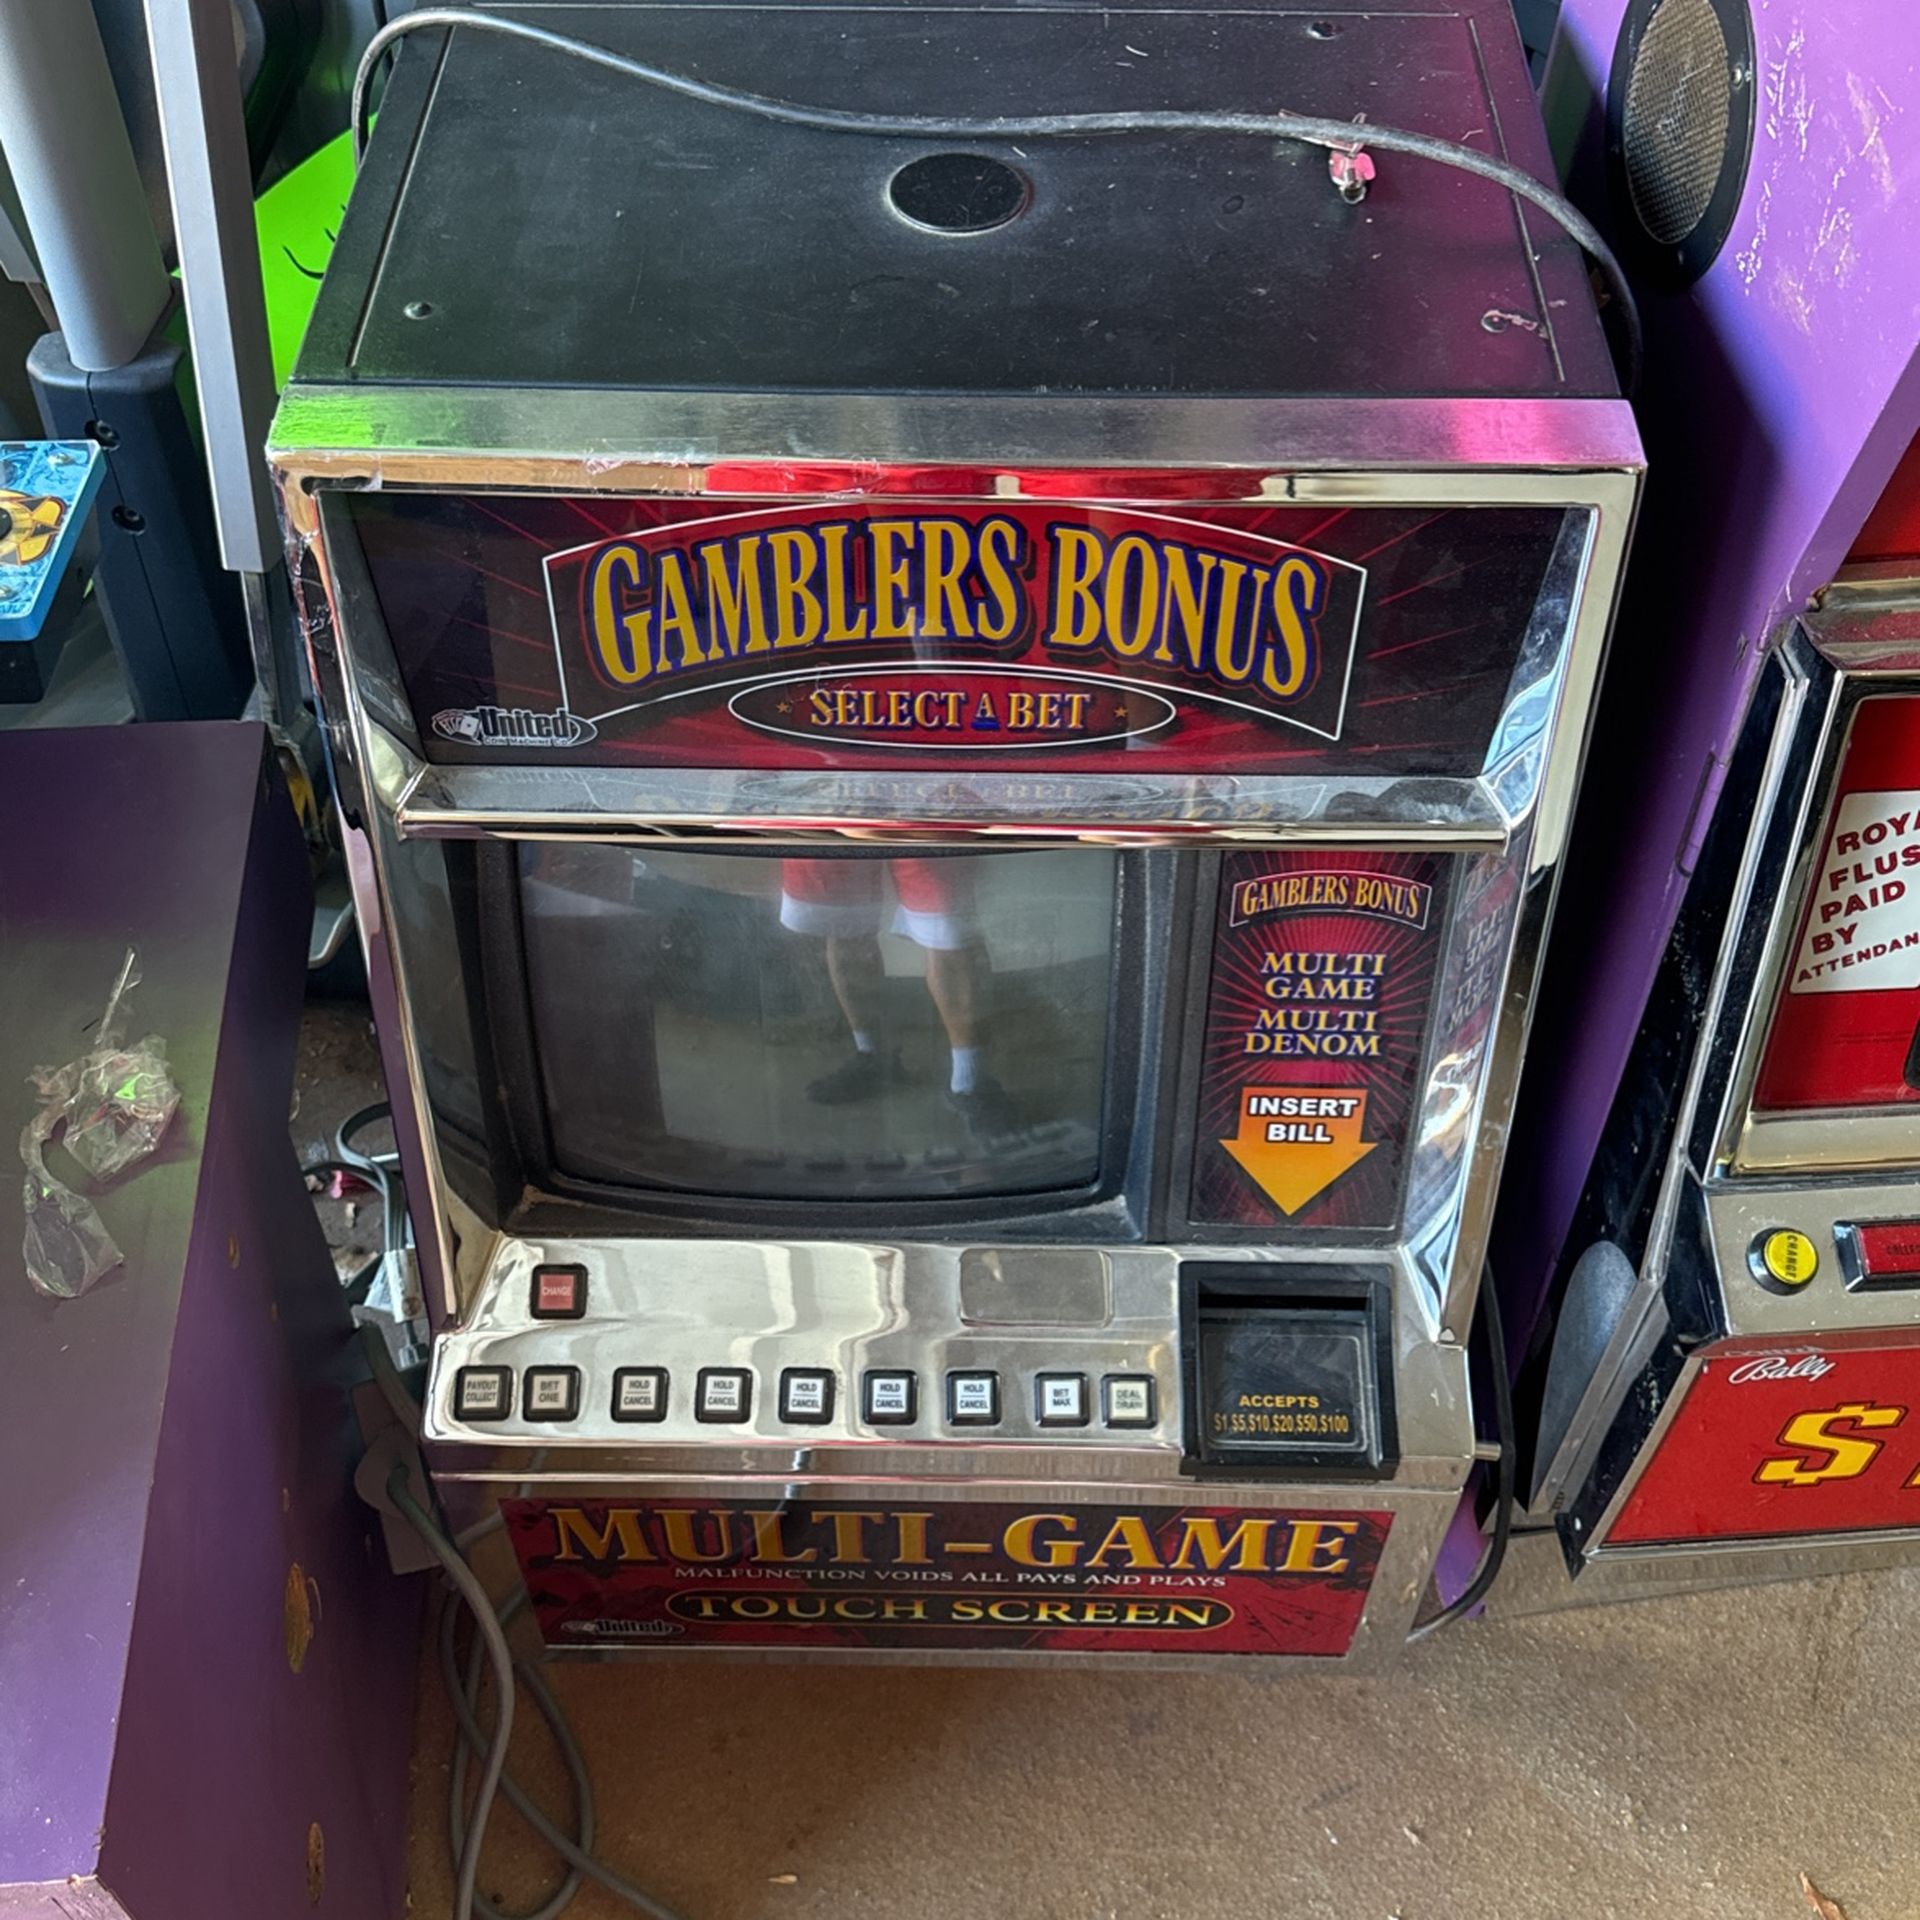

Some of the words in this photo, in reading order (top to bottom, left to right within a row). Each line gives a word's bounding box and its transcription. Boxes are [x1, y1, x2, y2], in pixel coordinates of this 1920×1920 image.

[592, 519, 1018, 685] GAMBLERS
[1049, 526, 1317, 696] BONUS
[810, 688, 965, 728] SELECT
[975, 693, 996, 718] A
[1007, 692, 1091, 729] BET
[477, 706, 572, 738] United
[1242, 876, 1349, 916] GAMBLERS
[1354, 876, 1419, 919] BONUS
[1820, 880, 1906, 924] PAID
[1811, 922, 1858, 955] BY
[1260, 952, 1386, 976] MULTI
[1264, 977, 1375, 1000] GAME
[1254, 1009, 1378, 1032] MULTI
[1244, 1033, 1381, 1056] DENOM
[1249, 1097, 1358, 1118] INSERT
[1266, 1123, 1332, 1143] BILL
[1785, 1234, 1798, 1279] CHANGE
[1728, 1355, 1836, 1385] Bally
[466, 1380, 498, 1391] PAYOUT
[540, 1380, 560, 1391] BET
[628, 1379, 650, 1389] HOLD
[713, 1380, 734, 1390] HOLD
[796, 1382, 817, 1391] HOLD
[879, 1382, 900, 1392] HOLD
[963, 1383, 984, 1393] HOLD
[465, 1391, 497, 1403] COLLECT
[538, 1392, 560, 1403] ONE
[1053, 1388, 1070, 1398] BET
[1116, 1390, 1141, 1399] DEAL
[623, 1395, 654, 1406] CANCEL
[707, 1396, 738, 1407] CANCEL
[790, 1398, 821, 1408] CANCEL
[875, 1398, 904, 1409] CANCEL
[959, 1399, 988, 1410] CANCEL
[1052, 1397, 1071, 1407] MAX
[1239, 1395, 1319, 1408] ACCEPTS
[675, 1567, 866, 1580] MALFUNCTION
[875, 1569, 953, 1582] VOIDS
[962, 1571, 1008, 1583] ALL
[1017, 1573, 1077, 1585] PAYS
[1083, 1574, 1141, 1587] AND
[1150, 1576, 1227, 1588] PLAYS
[686, 1596, 928, 1620] TOUCH
[951, 1600, 1215, 1626] SCREEN
